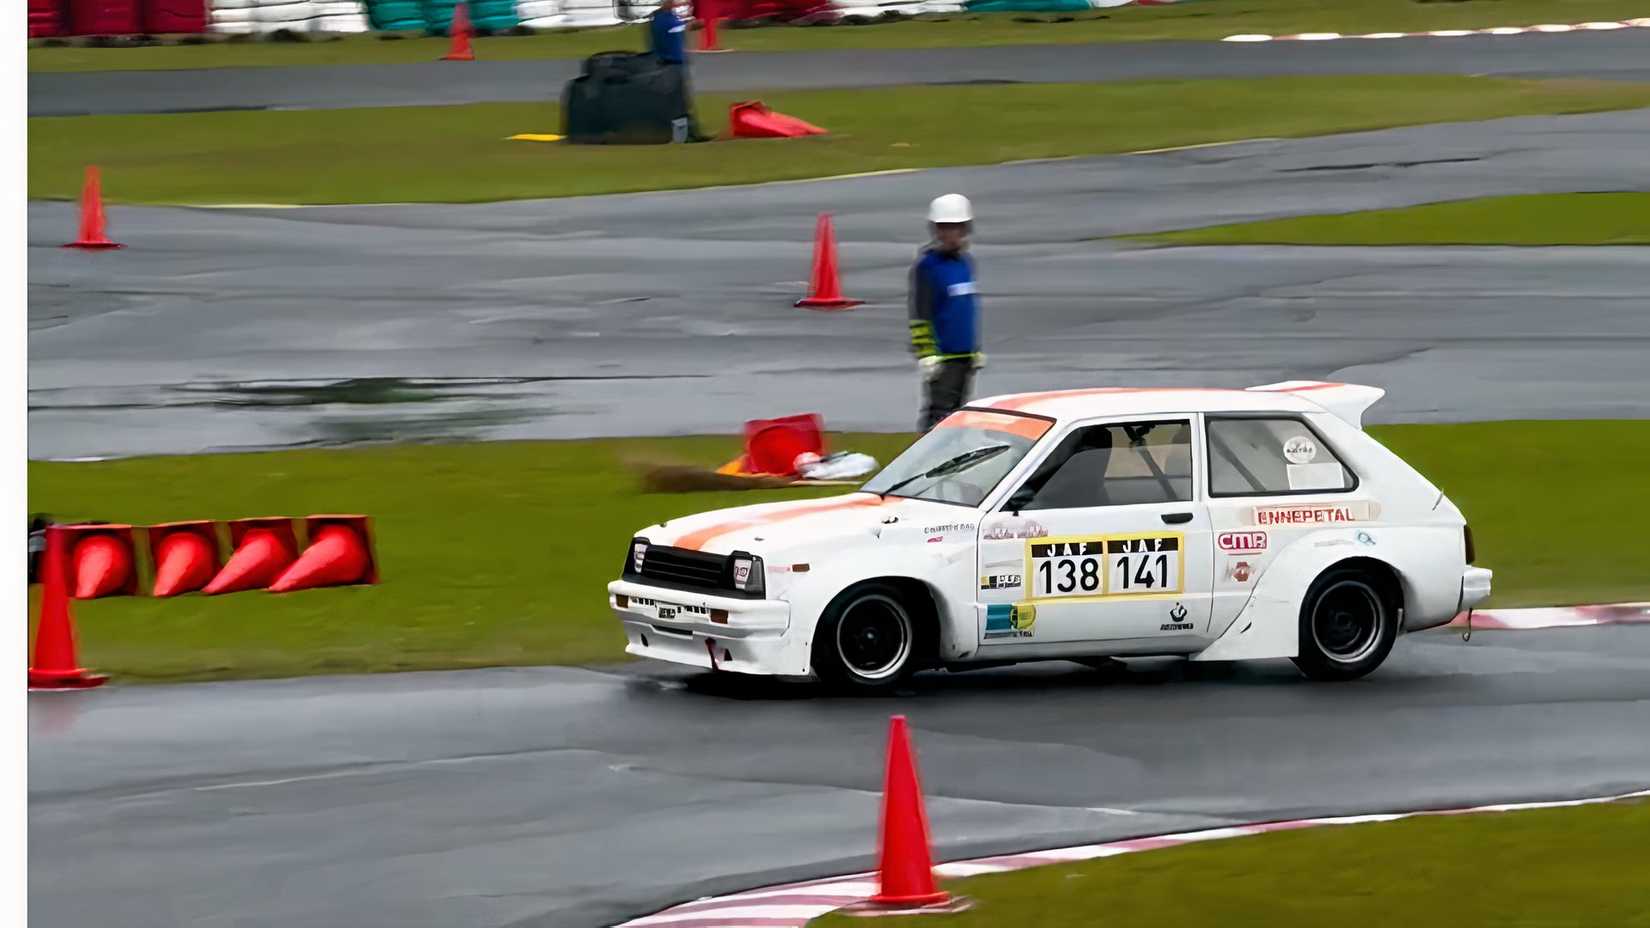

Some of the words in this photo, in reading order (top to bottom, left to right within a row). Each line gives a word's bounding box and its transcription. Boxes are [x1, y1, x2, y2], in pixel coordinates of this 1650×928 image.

[1257, 508, 1356, 525] ENNEPETAL
[1047, 542, 1088, 557] JAF
[1122, 538, 1163, 553] JAF
[1039, 558, 1100, 594] 138
[1116, 554, 1168, 589] 141
